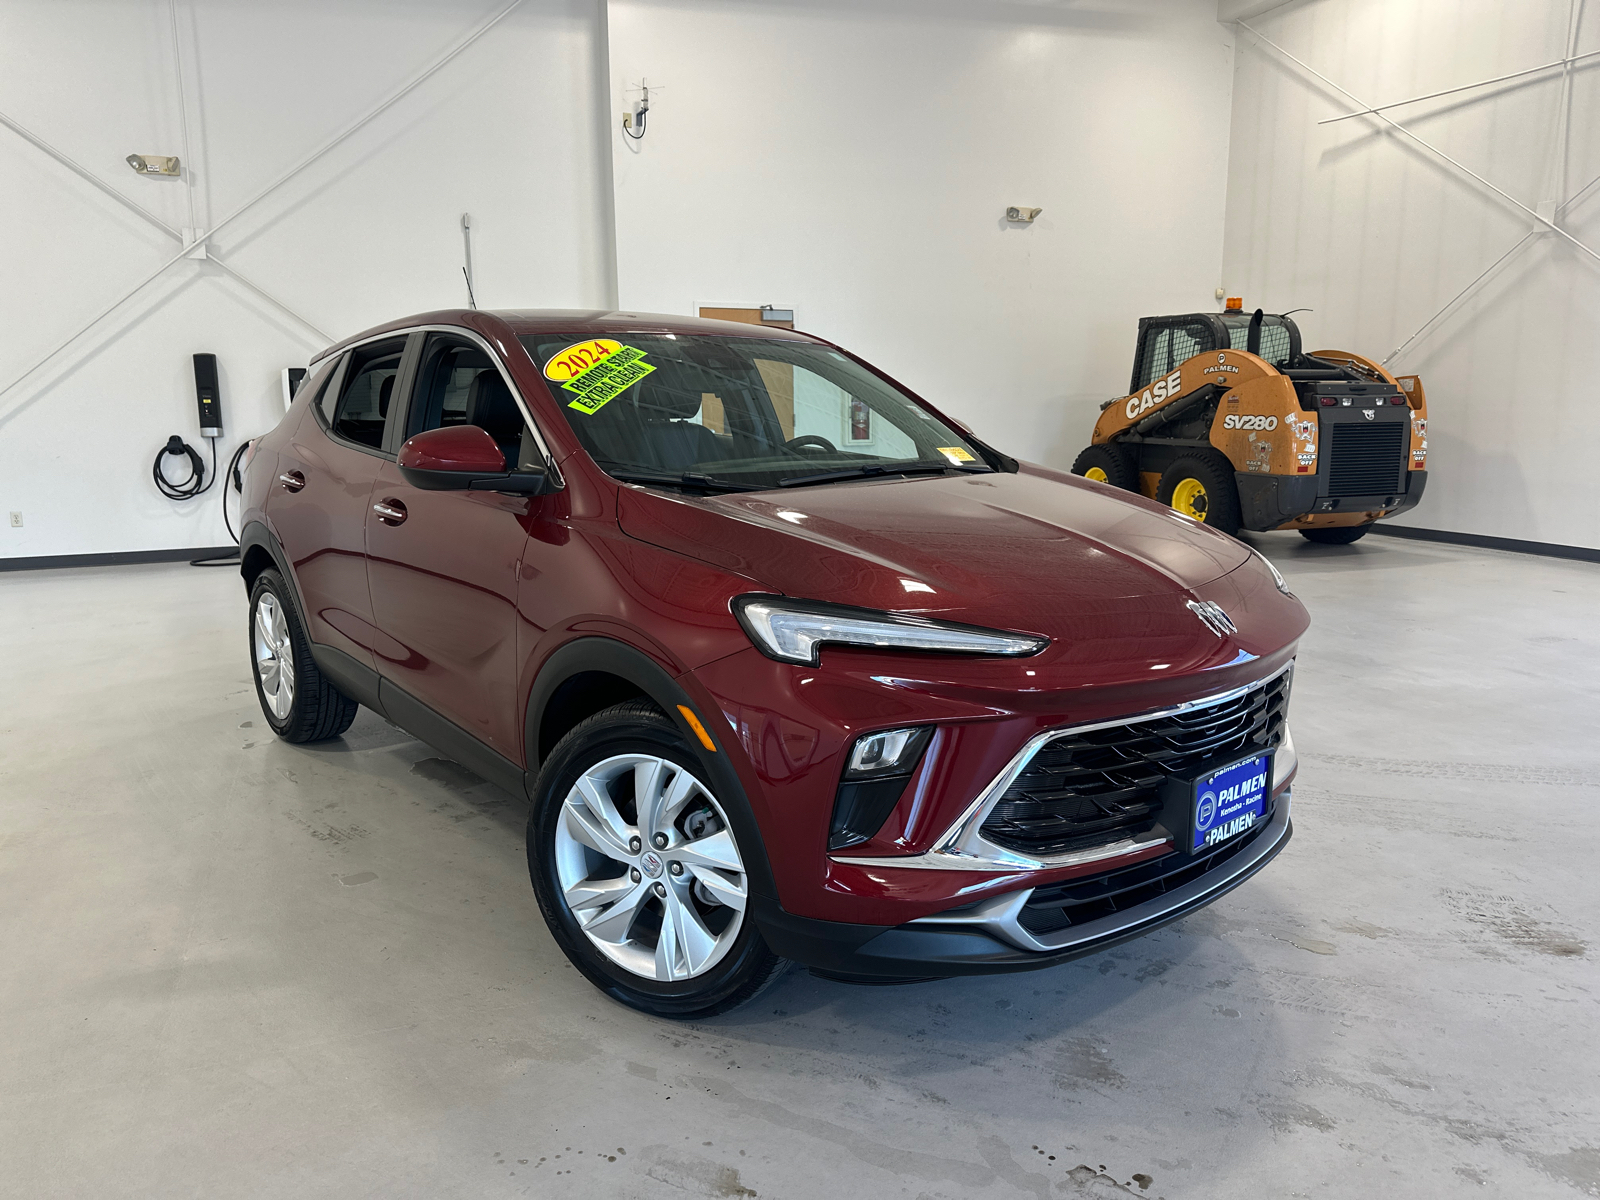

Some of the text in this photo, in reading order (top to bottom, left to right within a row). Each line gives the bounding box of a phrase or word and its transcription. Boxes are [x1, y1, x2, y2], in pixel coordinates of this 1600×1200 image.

[556, 341, 611, 377] 2024
[569, 347, 642, 392] REMOTE START
[1203, 365, 1239, 375] PALMEN
[576, 363, 648, 409] EXTRA CLEAN
[1125, 369, 1181, 419] CASE
[1223, 414, 1278, 431] SV280
[1213, 756, 1257, 779] palmen.com
[1218, 771, 1267, 807] PALMEN
[1220, 801, 1242, 817] Kenosha
[1245, 793, 1262, 806] Racine
[1209, 811, 1253, 846] PALMEN
